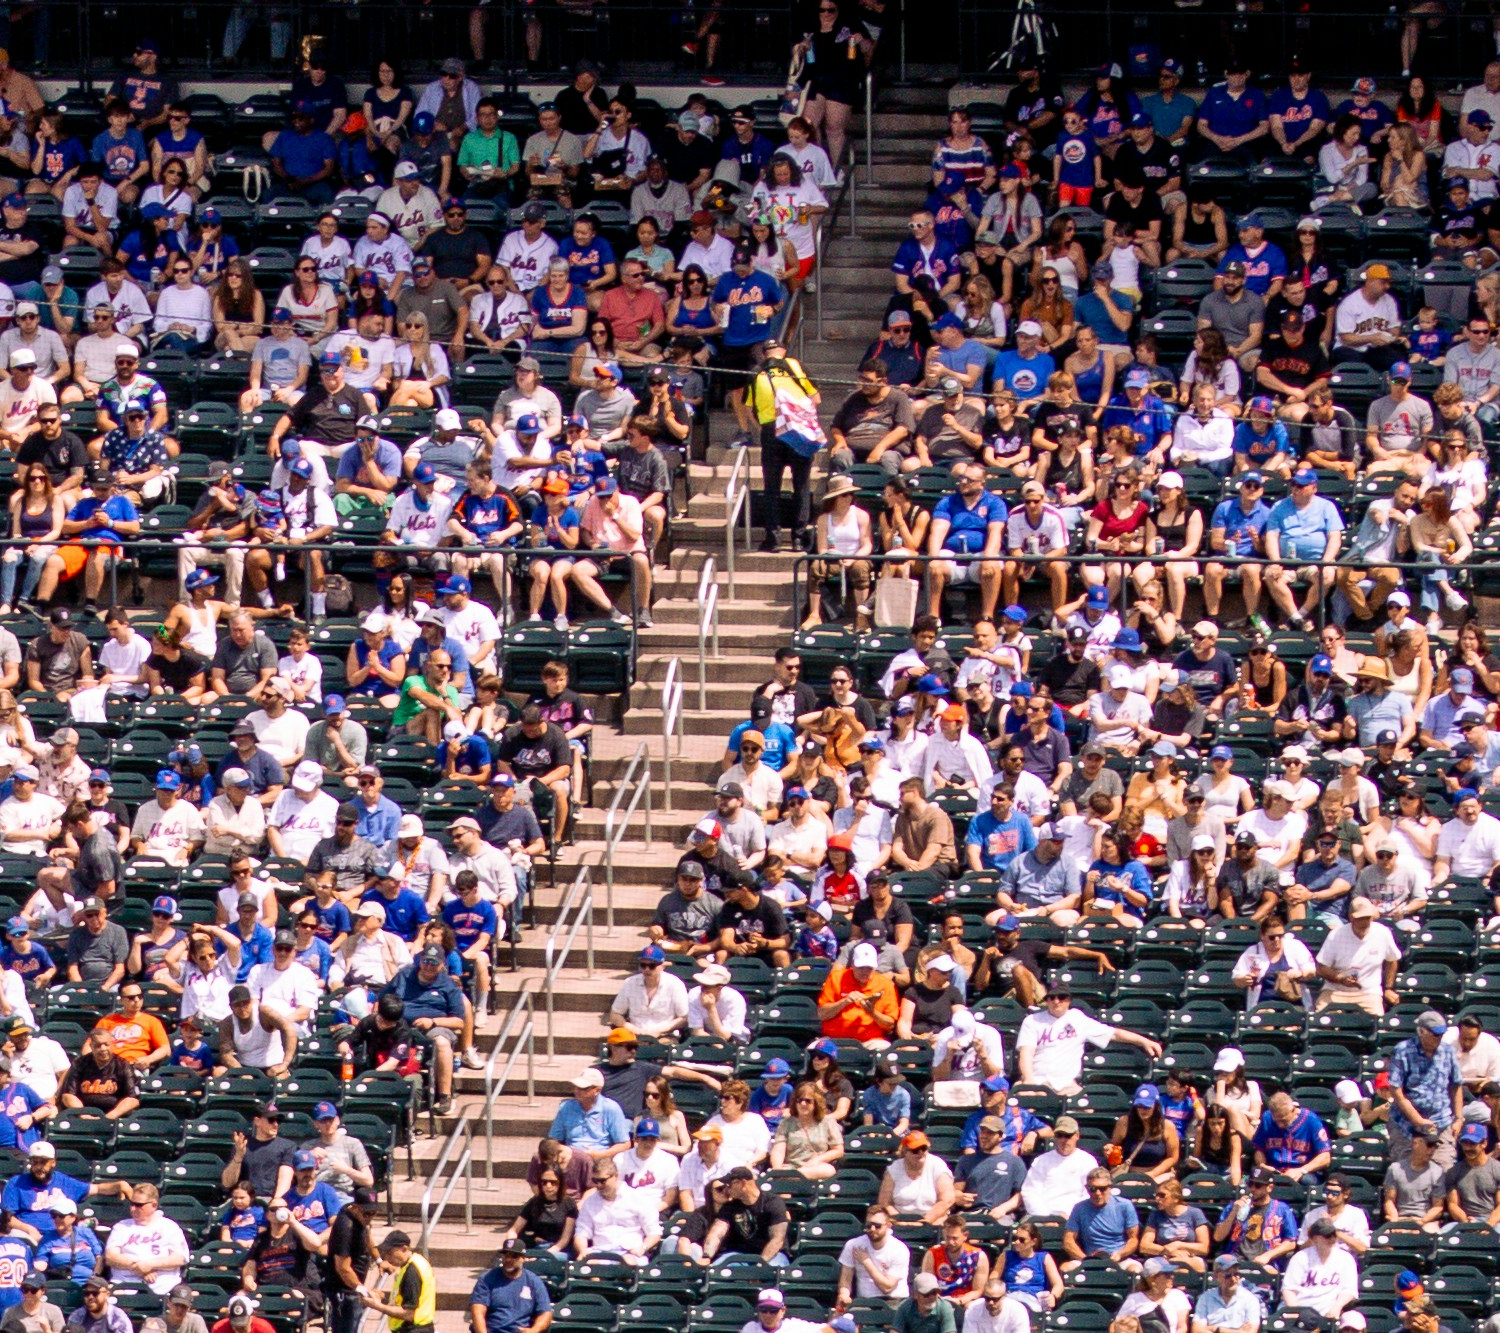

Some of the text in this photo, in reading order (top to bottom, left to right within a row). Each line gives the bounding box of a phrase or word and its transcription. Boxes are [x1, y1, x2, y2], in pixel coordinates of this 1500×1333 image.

[393, 212, 424, 230] Mets
[511, 255, 537, 271] Mets
[569, 250, 600, 265] Mets
[729, 286, 763, 304] Mets
[547, 307, 571, 317] METS
[407, 514, 436, 531] Mets
[148, 822, 183, 839] Mets
[283, 814, 321, 831] Mets
[1300, 1272, 1340, 1288] Mets
